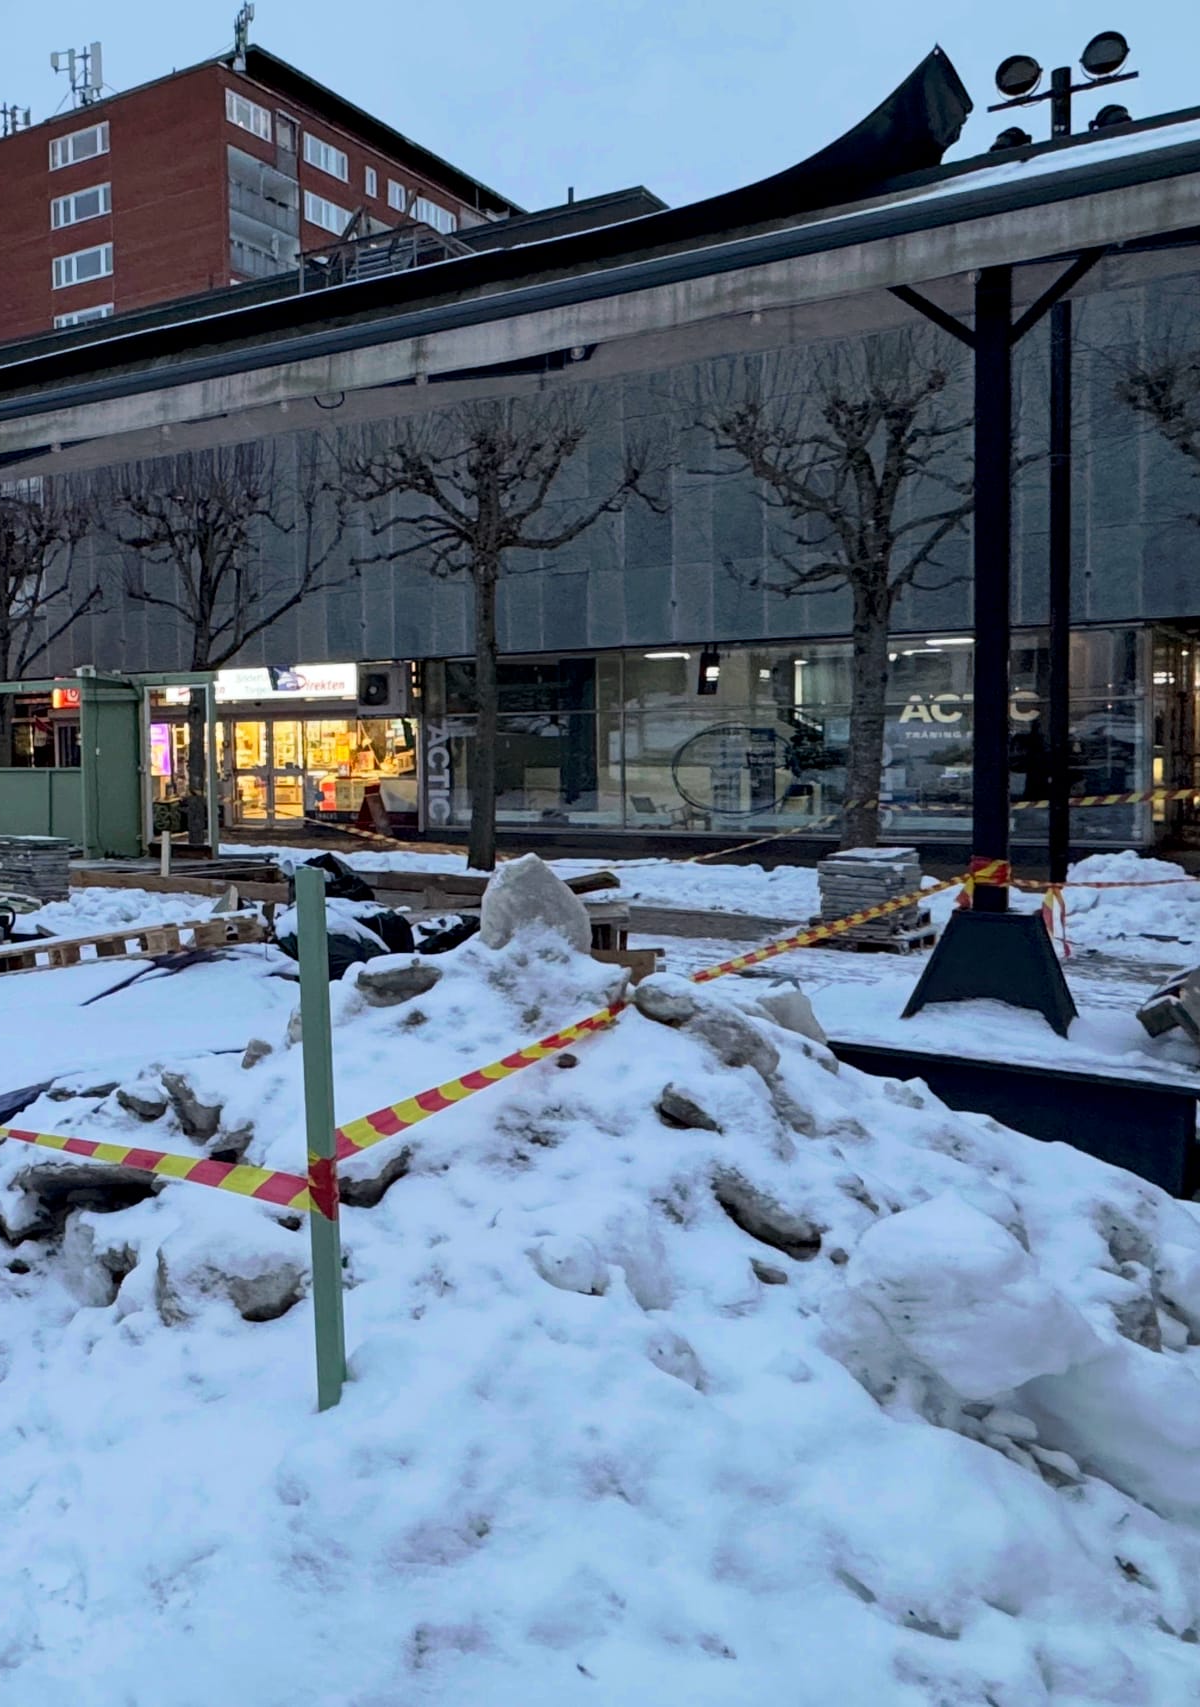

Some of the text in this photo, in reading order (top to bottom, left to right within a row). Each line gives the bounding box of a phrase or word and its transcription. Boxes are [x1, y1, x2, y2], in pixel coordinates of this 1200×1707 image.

[288, 674, 345, 691] Direkten
[899, 690, 1041, 723] ACC
[427, 723, 450, 821] ACTIC
